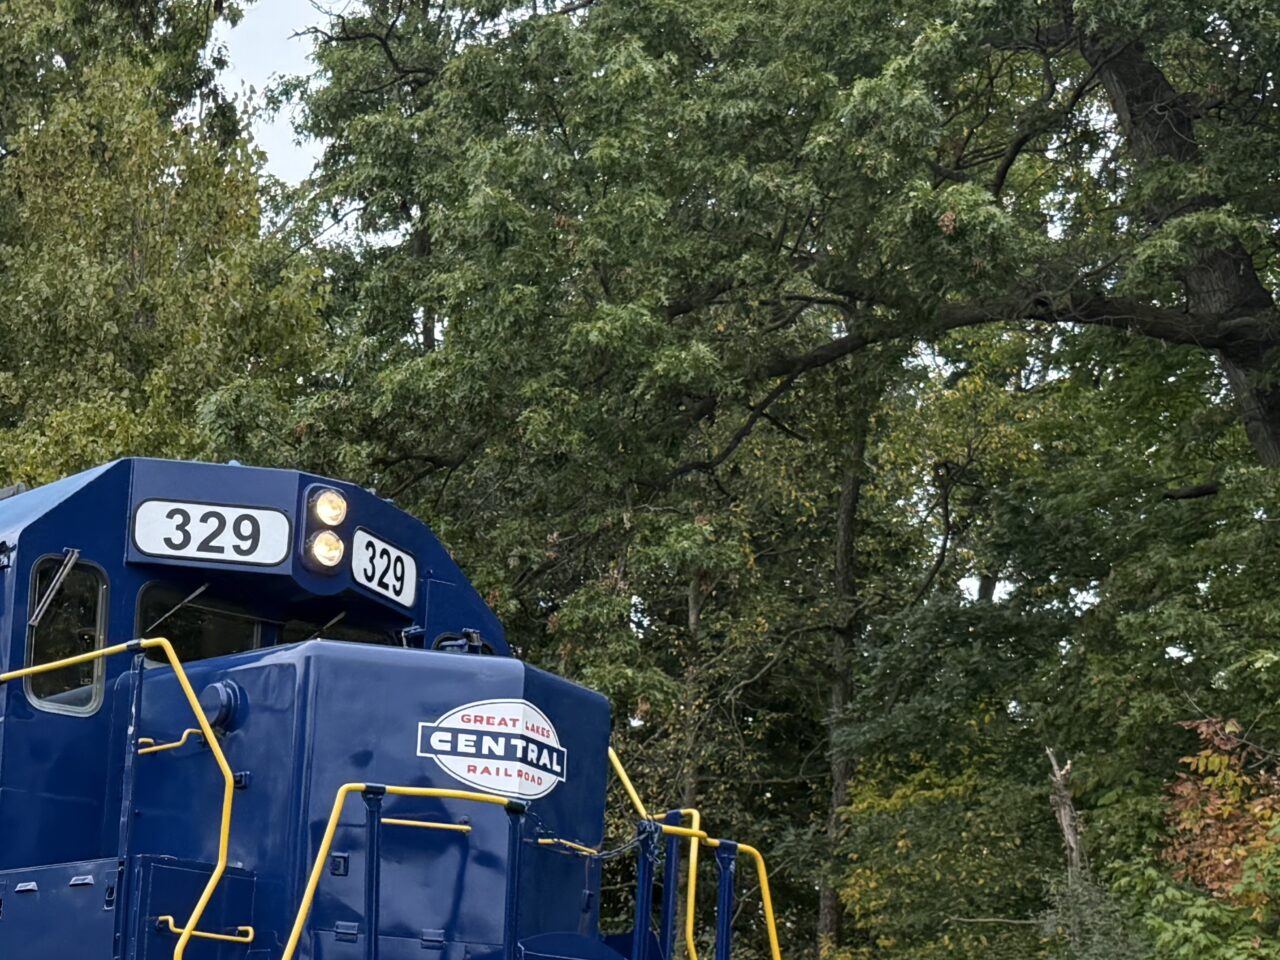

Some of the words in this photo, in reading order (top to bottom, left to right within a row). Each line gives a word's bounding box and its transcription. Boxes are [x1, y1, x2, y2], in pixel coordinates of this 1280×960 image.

[163, 508, 261, 557] 329
[363, 540, 405, 597] 329
[461, 714, 520, 728] GREAT
[525, 720, 551, 739] LAKES
[430, 731, 562, 773] CENTRAL
